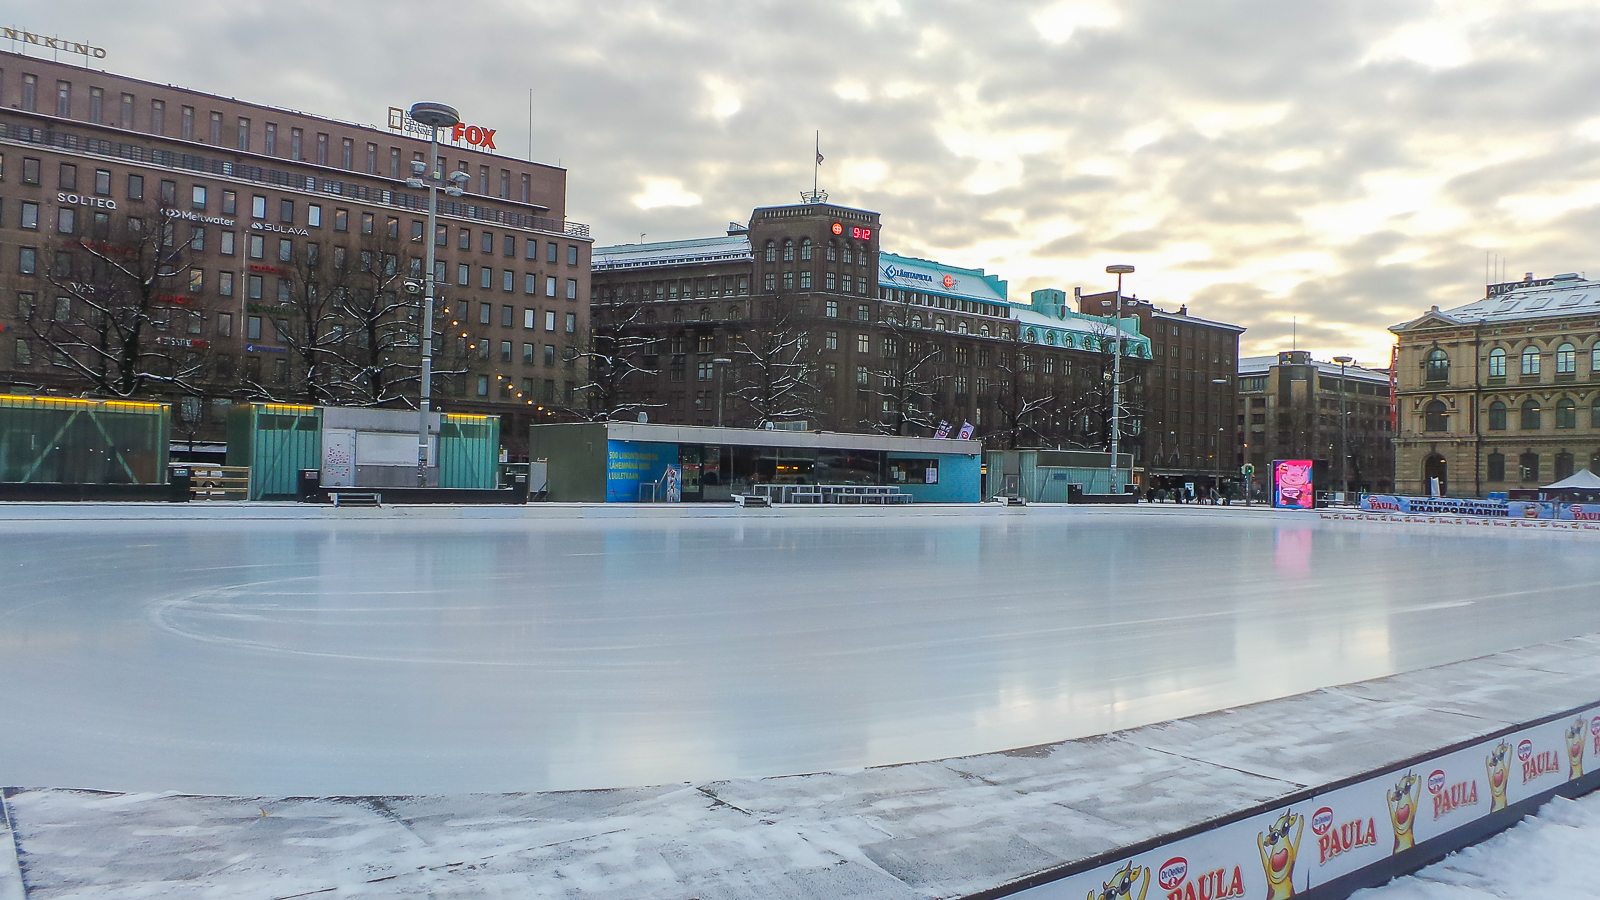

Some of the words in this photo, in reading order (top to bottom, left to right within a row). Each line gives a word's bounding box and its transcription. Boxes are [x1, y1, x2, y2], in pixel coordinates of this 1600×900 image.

[453, 122, 497, 150] FOX
[57, 192, 117, 210] SOLTEQ
[181, 210, 235, 226] Meltwater
[264, 223, 310, 237] SULAVA
[1371, 502, 1400, 511] PAULA
[1522, 750, 1559, 785] PAULA
[1433, 779, 1478, 821] PAULA
[1318, 816, 1377, 866] PAULA
